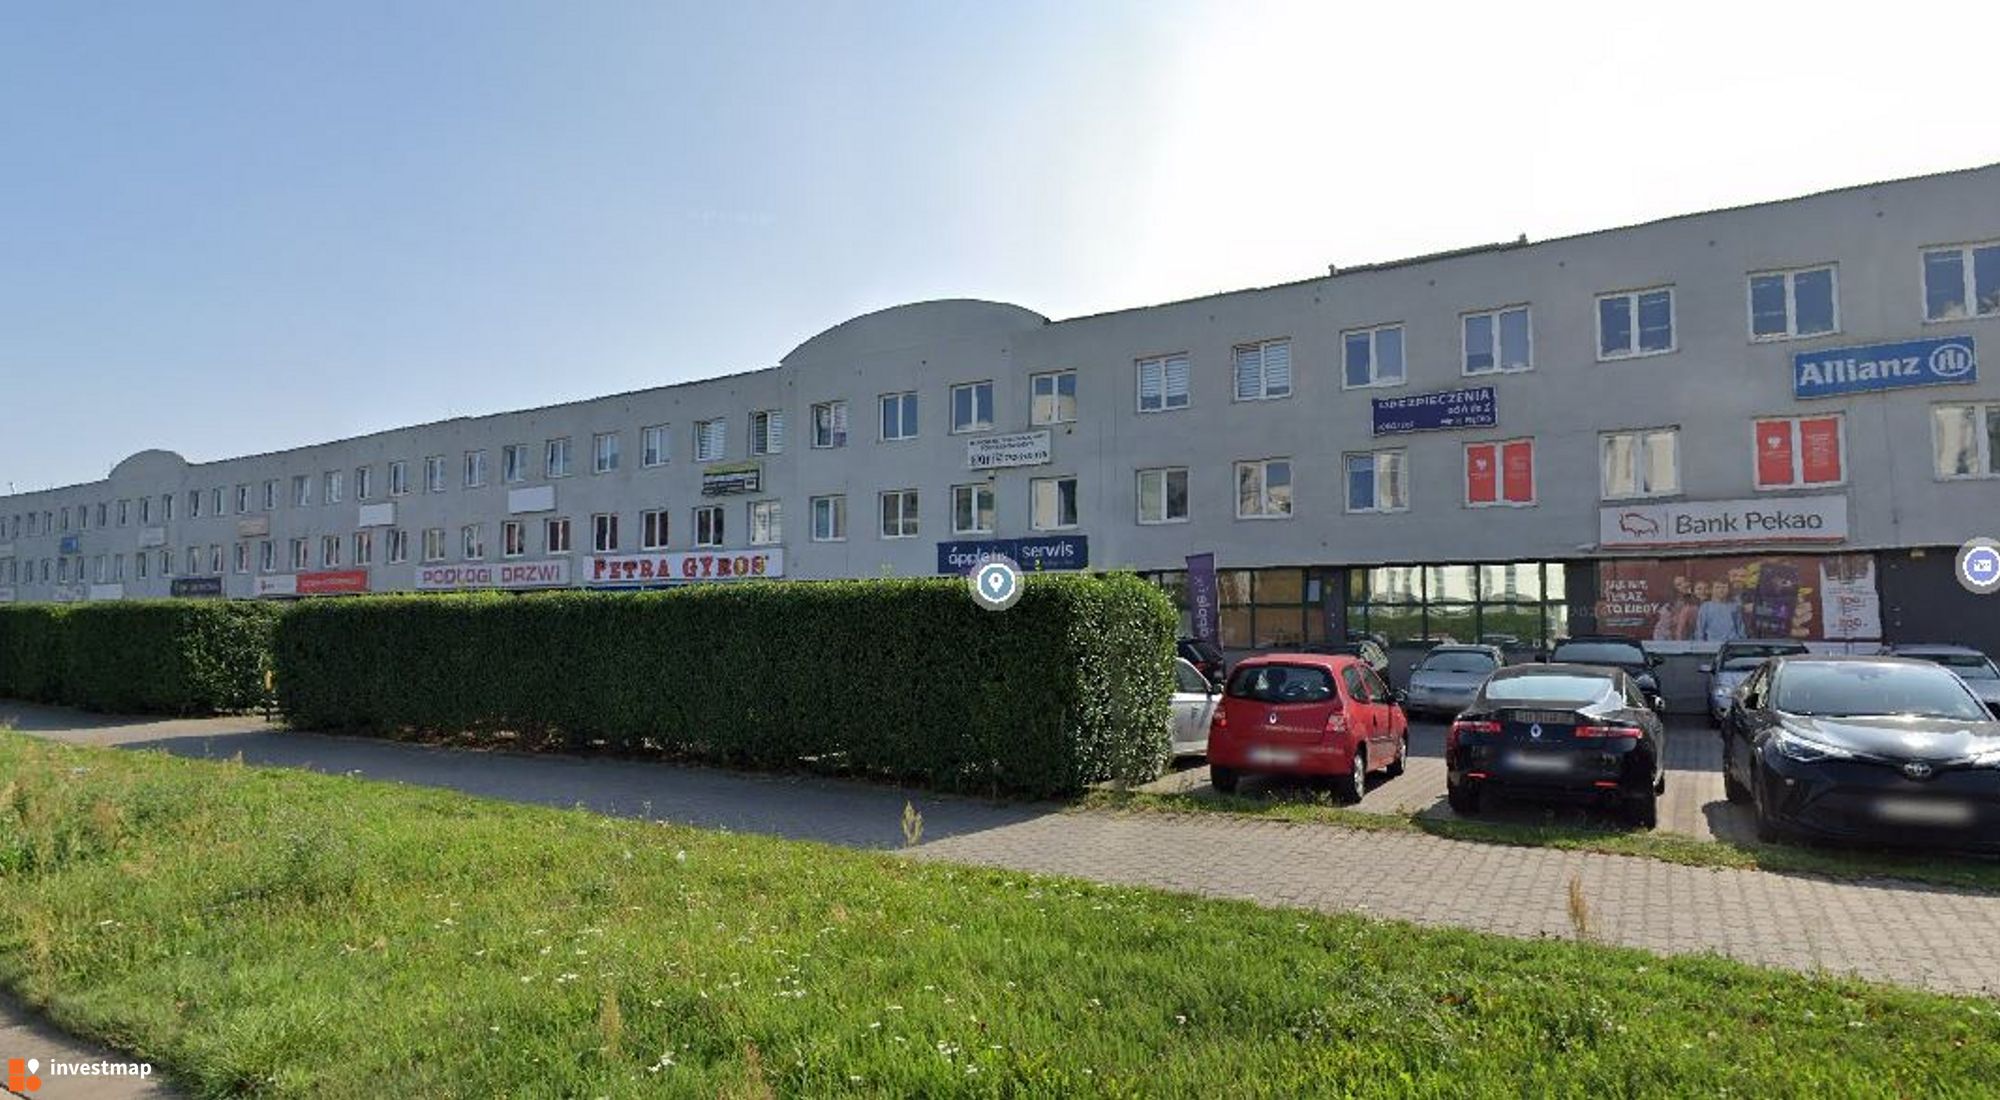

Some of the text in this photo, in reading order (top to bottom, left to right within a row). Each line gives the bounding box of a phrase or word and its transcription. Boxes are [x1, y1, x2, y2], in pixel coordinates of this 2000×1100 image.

[1799, 356, 1921, 386] Allianz
[1675, 510, 1823, 535] Bank Pekao
[1022, 541, 1075, 559] serwis
[501, 564, 561, 583] DRZWI
[593, 554, 767, 580] PETRA GYROS
